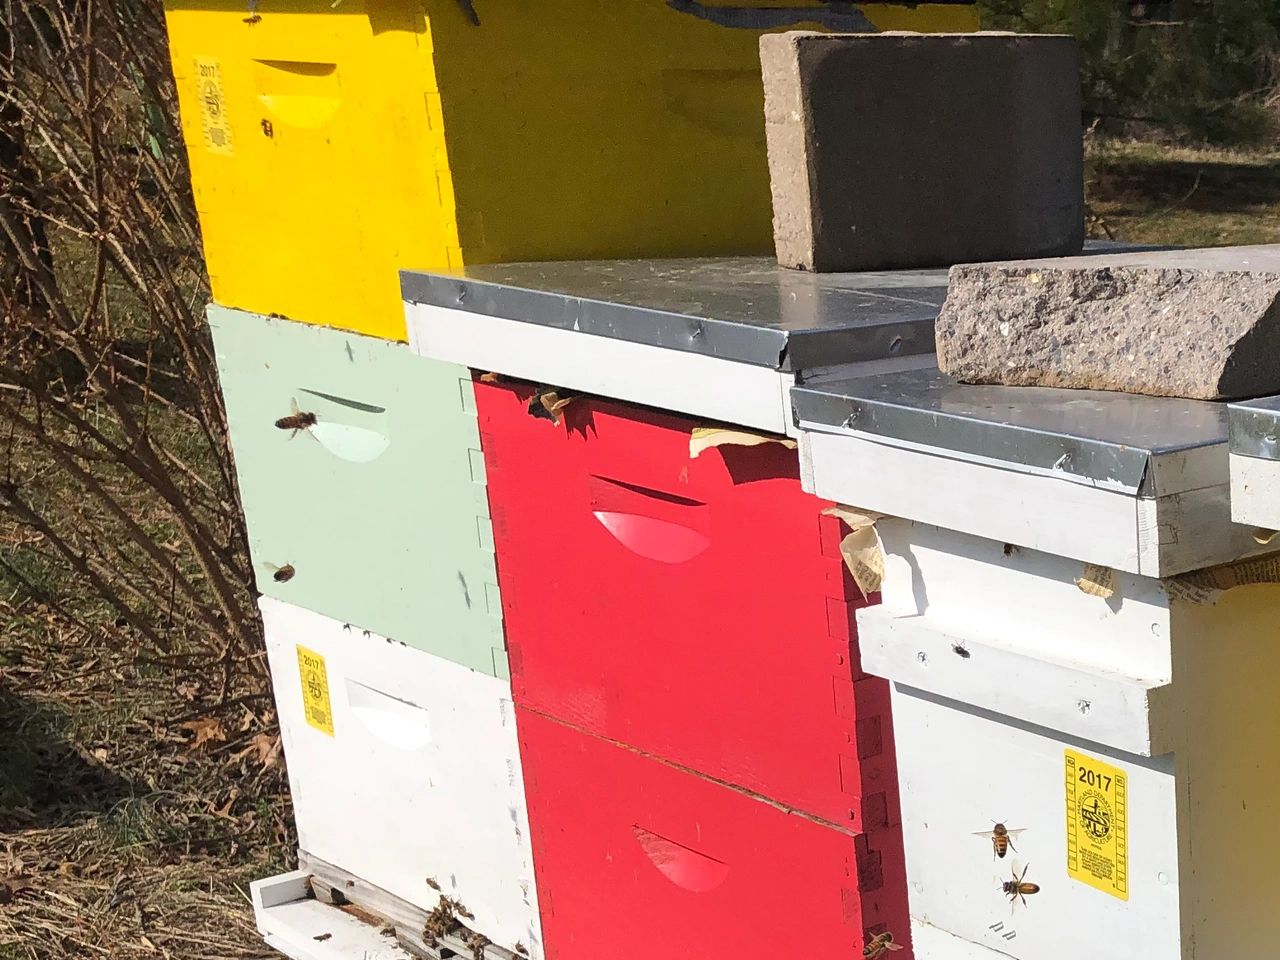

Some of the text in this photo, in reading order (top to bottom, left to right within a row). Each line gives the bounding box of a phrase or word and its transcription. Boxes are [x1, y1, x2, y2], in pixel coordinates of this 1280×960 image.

[200, 64, 215, 77] 2017
[304, 654, 319, 670] 2017
[1079, 766, 1111, 791] 2017
